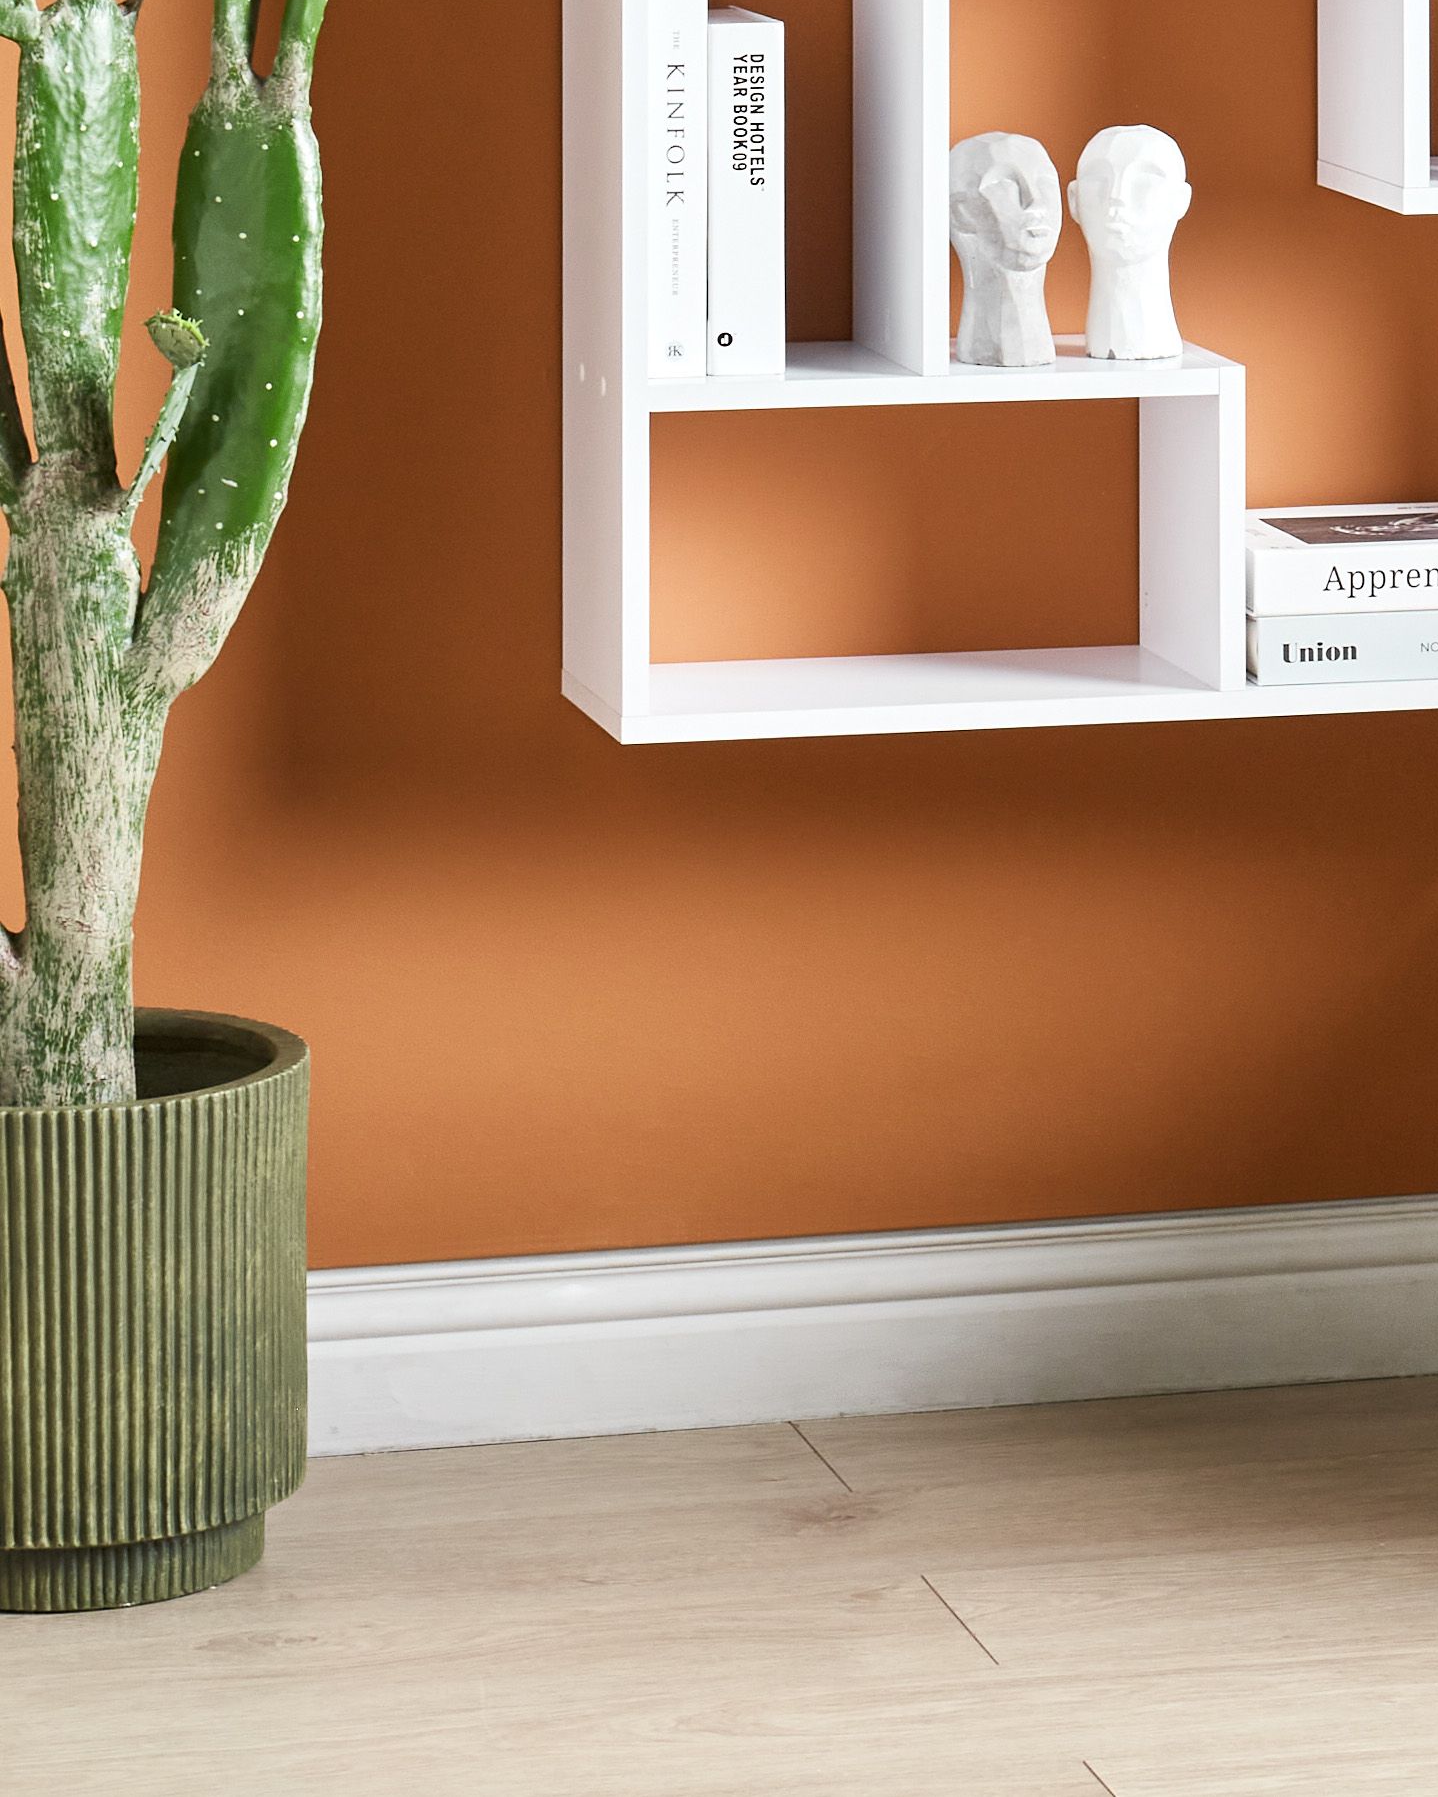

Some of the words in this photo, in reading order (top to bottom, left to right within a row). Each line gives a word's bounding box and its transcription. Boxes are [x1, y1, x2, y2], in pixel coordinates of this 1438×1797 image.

[672, 31, 681, 50] THE
[733, 54, 747, 98] YEAR
[750, 54, 764, 114] DESIGN
[666, 64, 685, 206] KINFOLK
[750, 122, 764, 186] HOTELS
[1283, 641, 1357, 664] Union
